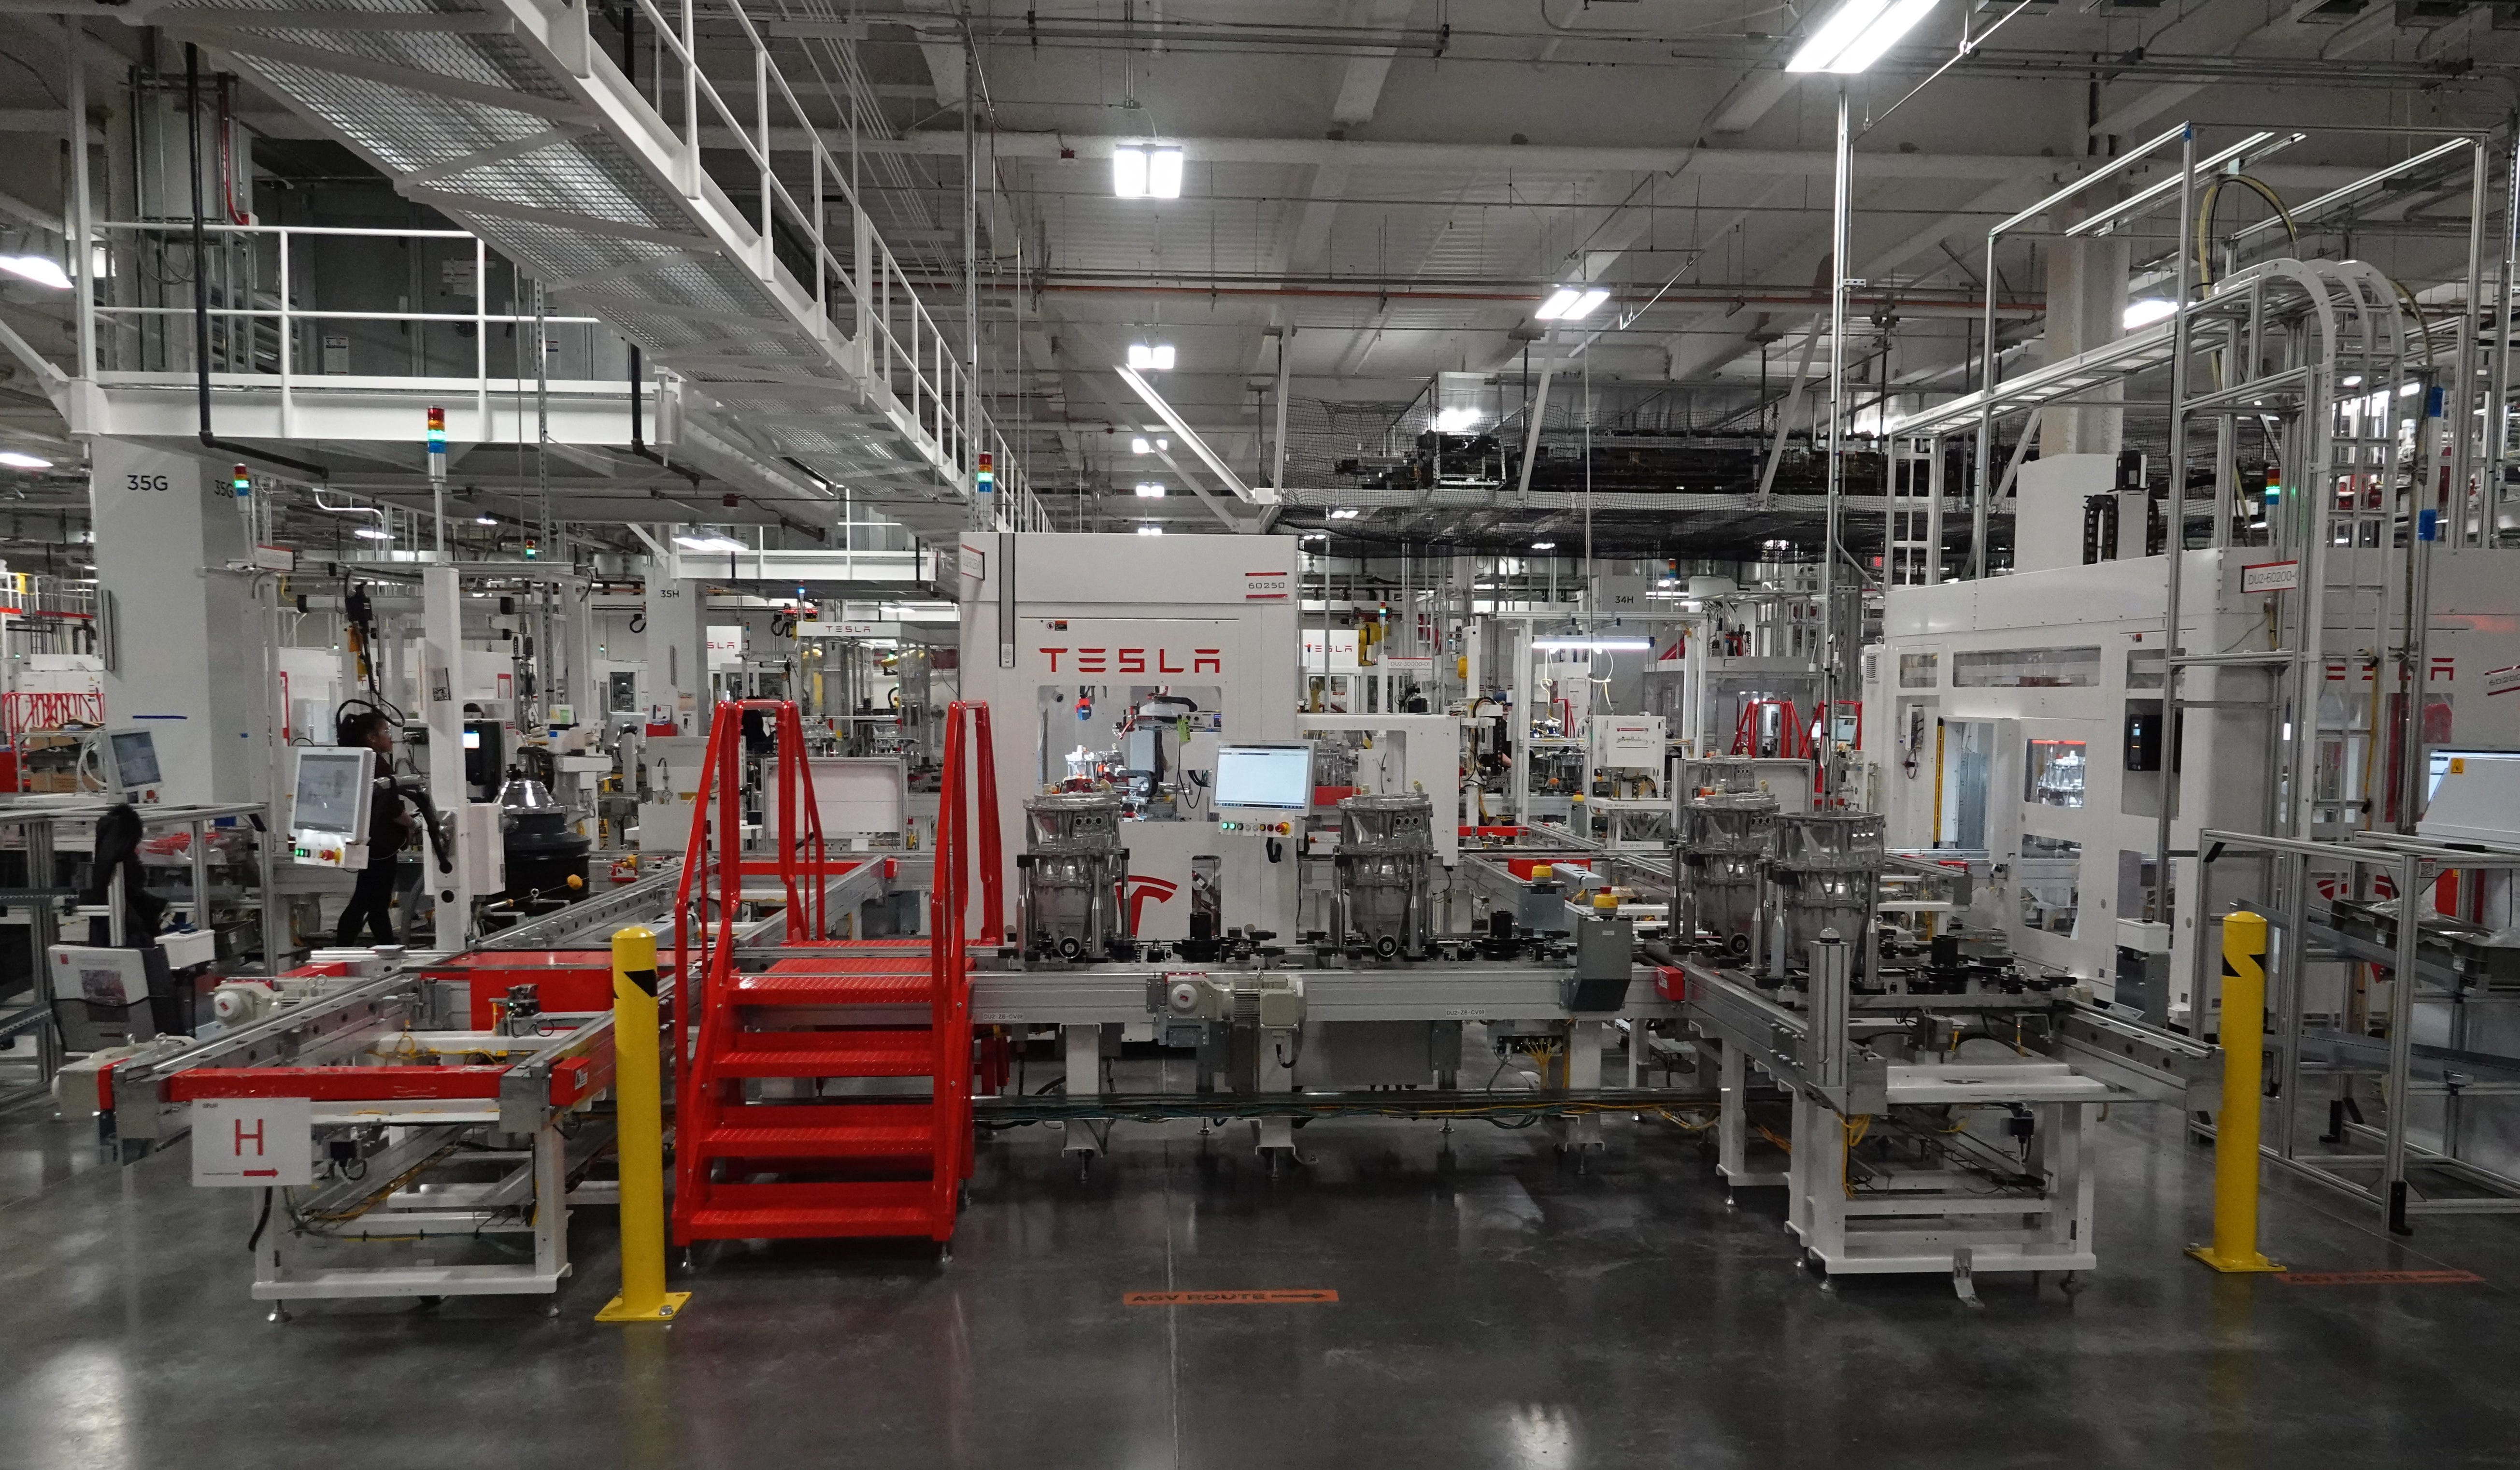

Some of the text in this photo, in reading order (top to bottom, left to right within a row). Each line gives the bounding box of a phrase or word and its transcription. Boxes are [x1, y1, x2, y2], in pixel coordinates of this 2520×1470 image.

[127, 474, 168, 491] 35G
[214, 479, 234, 499] 35G
[660, 590, 680, 598] 35H
[1039, 648, 1220, 673] TESLA
[234, 1118, 264, 1156] H
